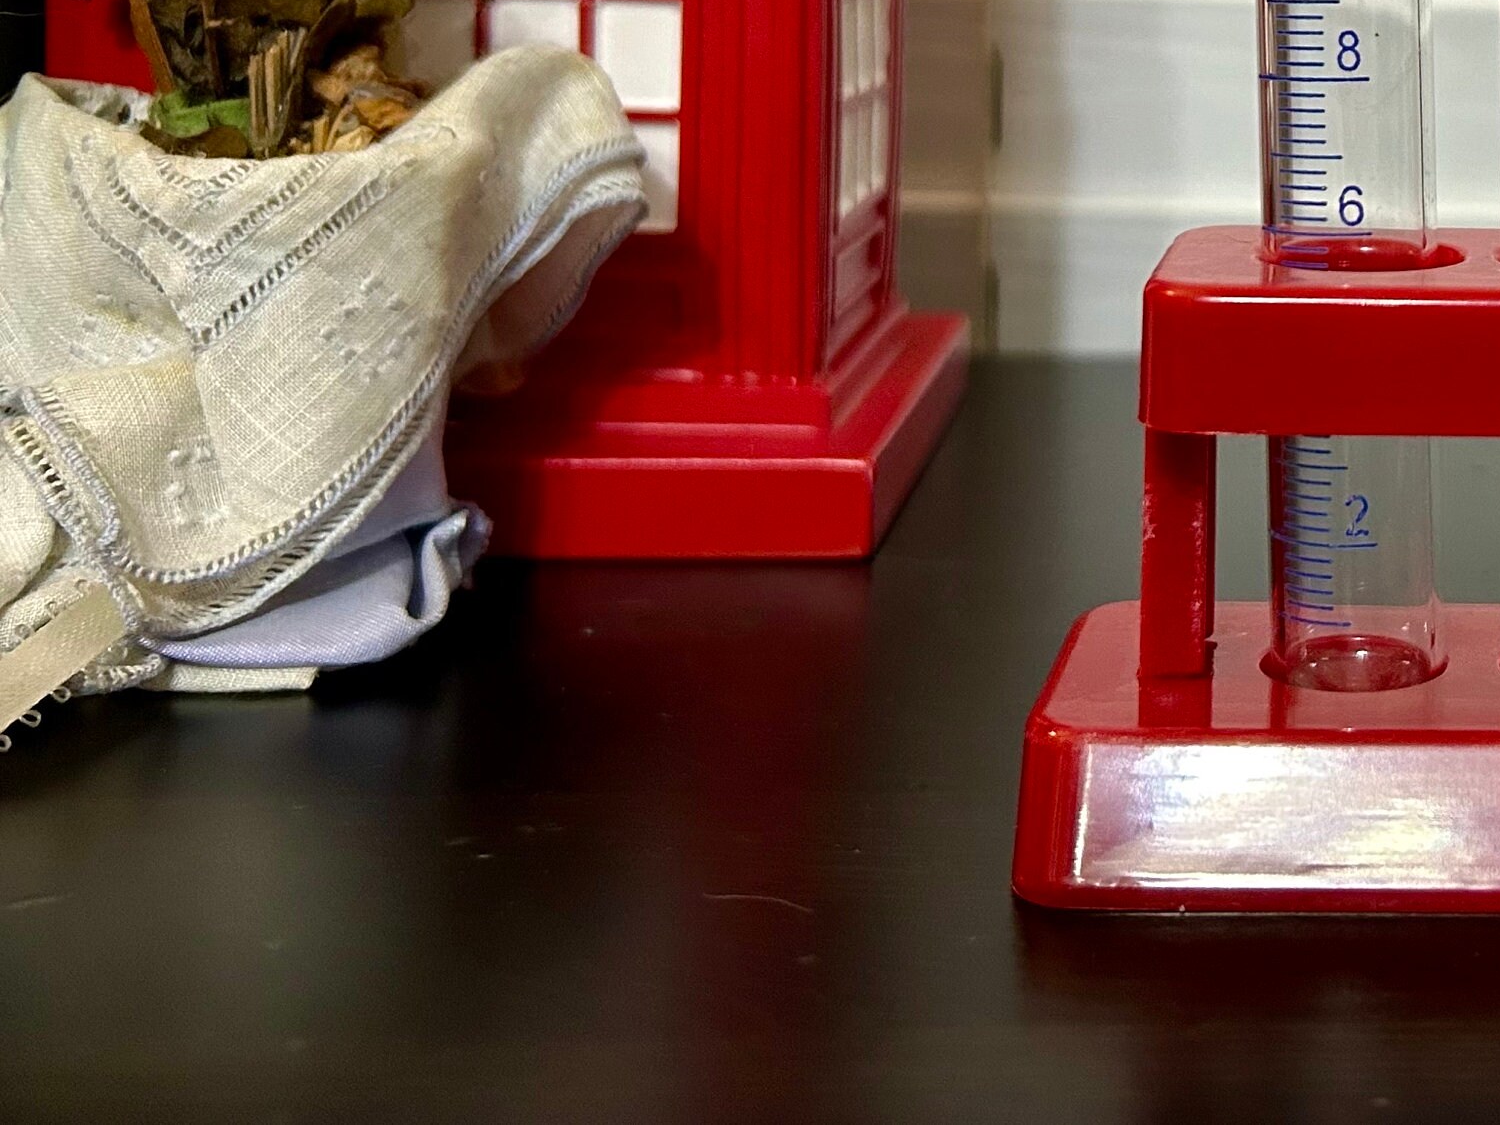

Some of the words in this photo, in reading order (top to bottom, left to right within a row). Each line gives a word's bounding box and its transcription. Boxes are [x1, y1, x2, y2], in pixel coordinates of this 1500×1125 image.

[1336, 29, 1361, 71] 8
[1338, 185, 1364, 226] 6
[1345, 494, 1370, 536] 2
